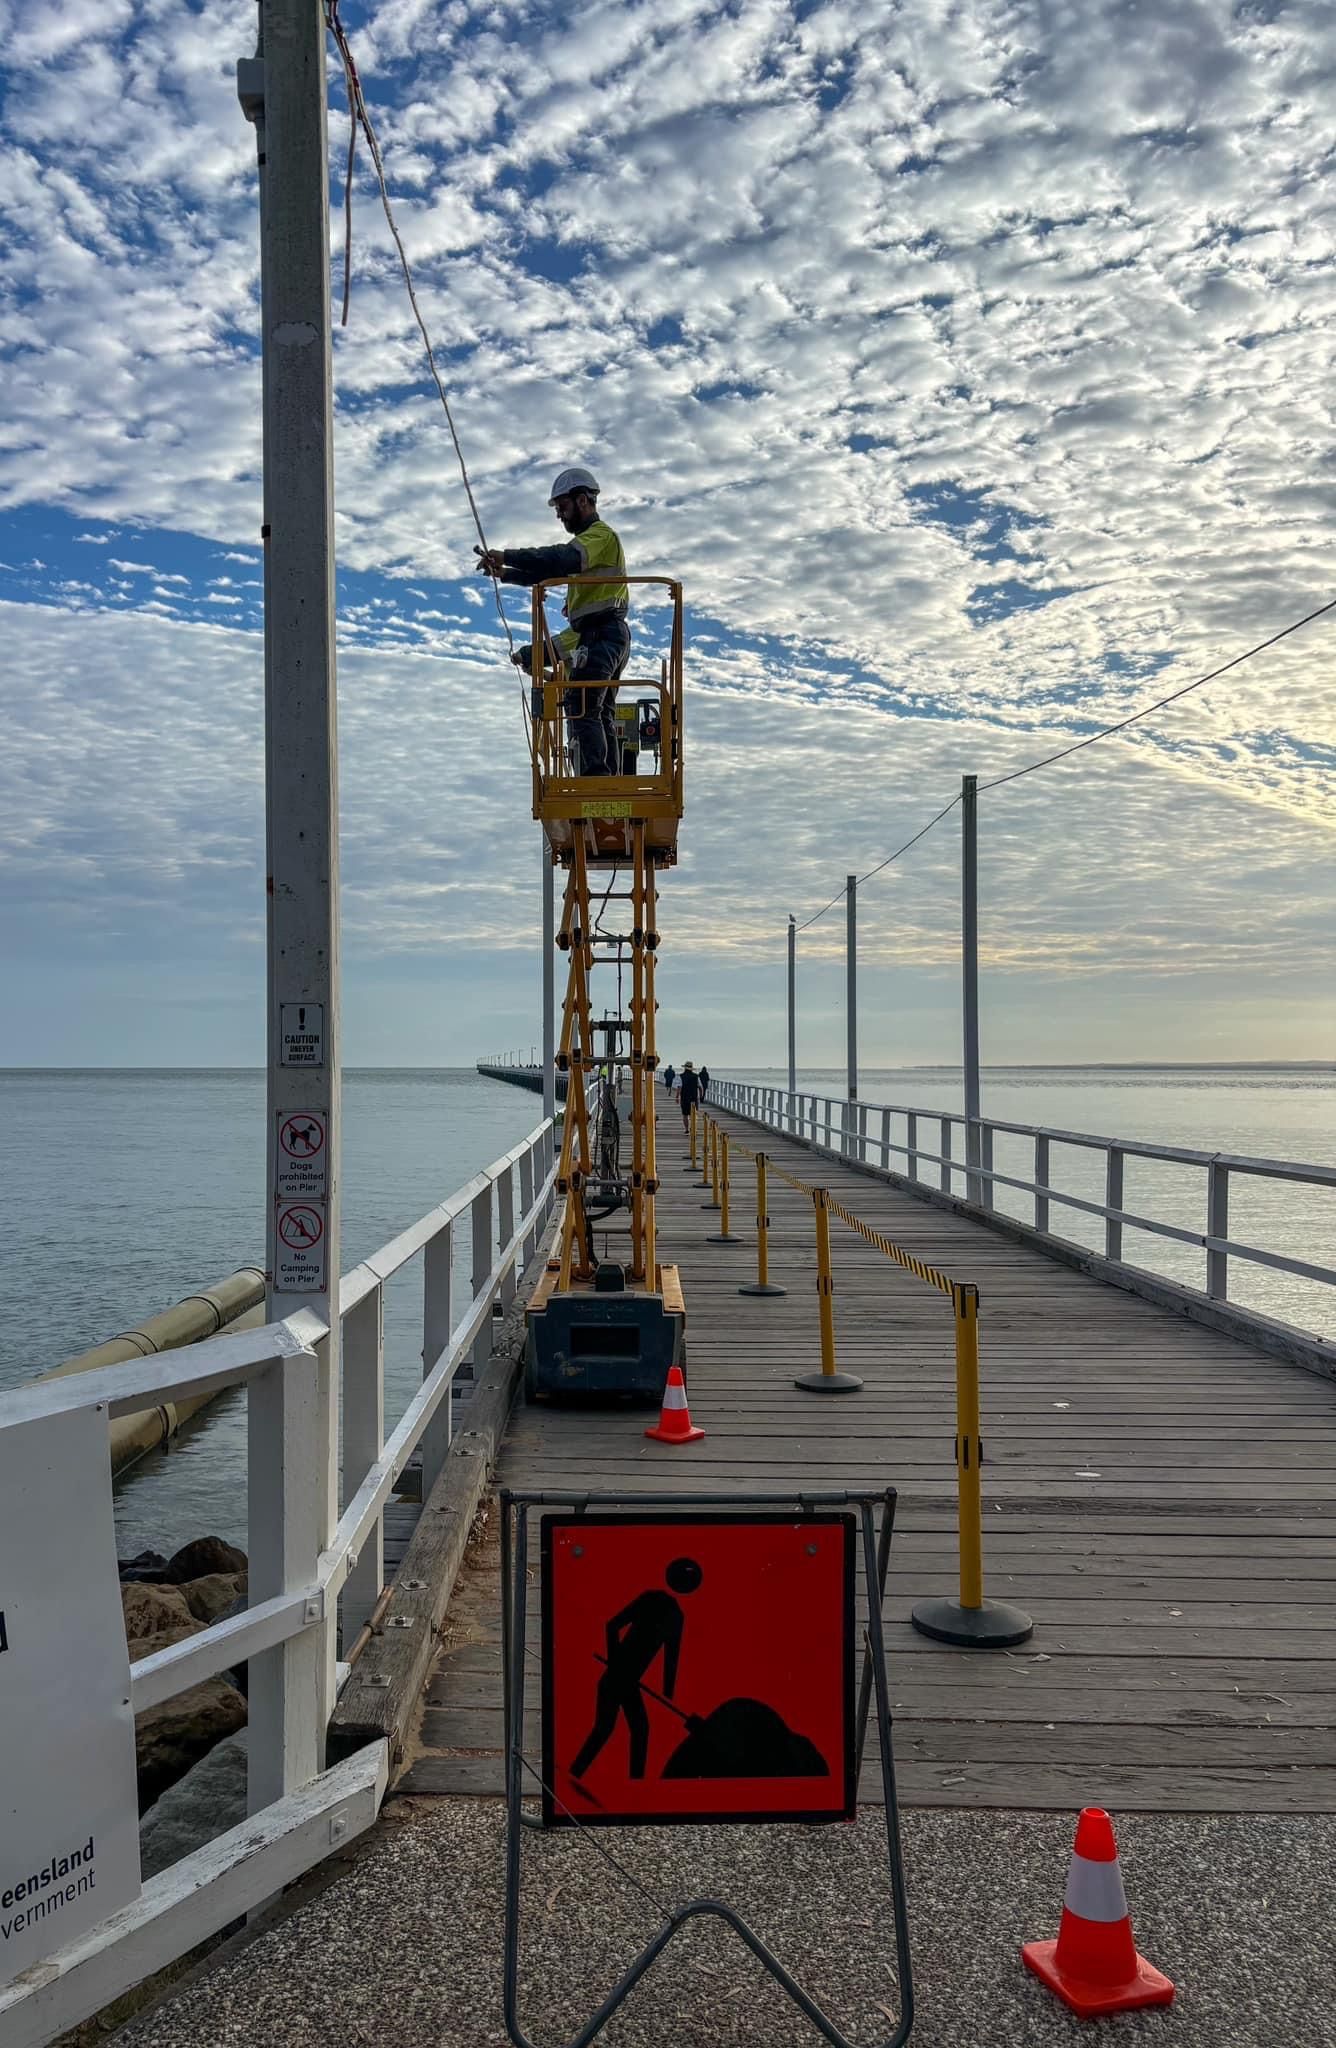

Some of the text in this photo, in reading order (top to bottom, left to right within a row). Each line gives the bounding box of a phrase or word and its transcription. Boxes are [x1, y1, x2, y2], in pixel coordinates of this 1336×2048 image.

[285, 1034, 320, 1044] CAUTION
[290, 1162, 313, 1171] Dogs
[280, 1173, 323, 1182] prohibited
[300, 1184, 317, 1192] Pier
[294, 1253, 306, 1261] No
[280, 1264, 320, 1274] Camping
[298, 1275, 315, 1283] Pier
[1, 1836, 95, 1909] eensland
[1, 1868, 96, 1940] vernment
